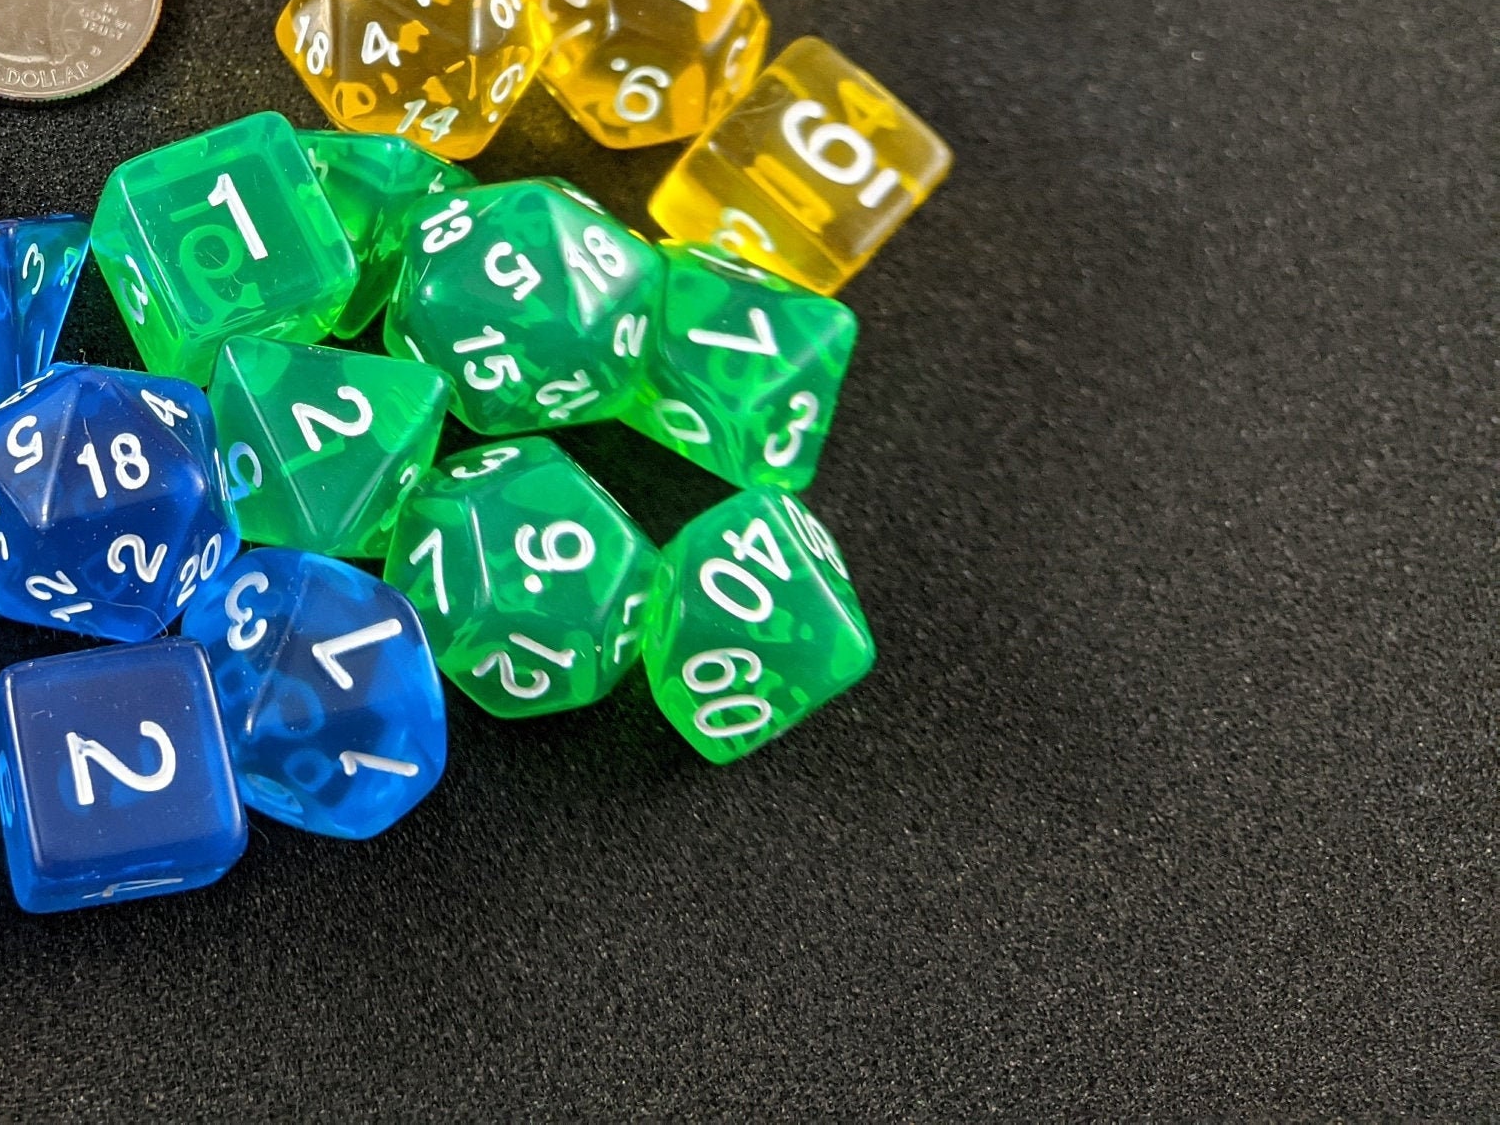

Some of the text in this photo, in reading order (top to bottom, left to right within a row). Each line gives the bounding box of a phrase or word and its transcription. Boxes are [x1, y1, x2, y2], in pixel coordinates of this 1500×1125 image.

[293, 15, 329, 75] 18
[360, 20, 401, 66] 4
[4, 60, 90, 89] DOLLAR
[396, 98, 459, 143] 14
[206, 172, 270, 261] 1
[419, 198, 473, 254] 13
[21, 242, 46, 296] 3
[484, 240, 542, 302] 5
[565, 224, 626, 294] 18
[452, 324, 522, 392] 15
[612, 312, 647, 358] 2
[686, 306, 780, 356] 7
[139, 388, 189, 428] 4
[291, 385, 373, 452] 2
[535, 368, 600, 420] 12
[6, 414, 44, 474] 5
[763, 390, 820, 468] 3
[76, 432, 150, 499] 18
[106, 532, 168, 584] 2
[176, 531, 221, 608] 20
[699, 516, 792, 624] 40
[24, 569, 93, 623] 12
[224, 570, 270, 651] 3
[311, 617, 403, 690] 7
[472, 631, 576, 699] 12
[65, 719, 177, 806] 2
[338, 750, 420, 778] 1
